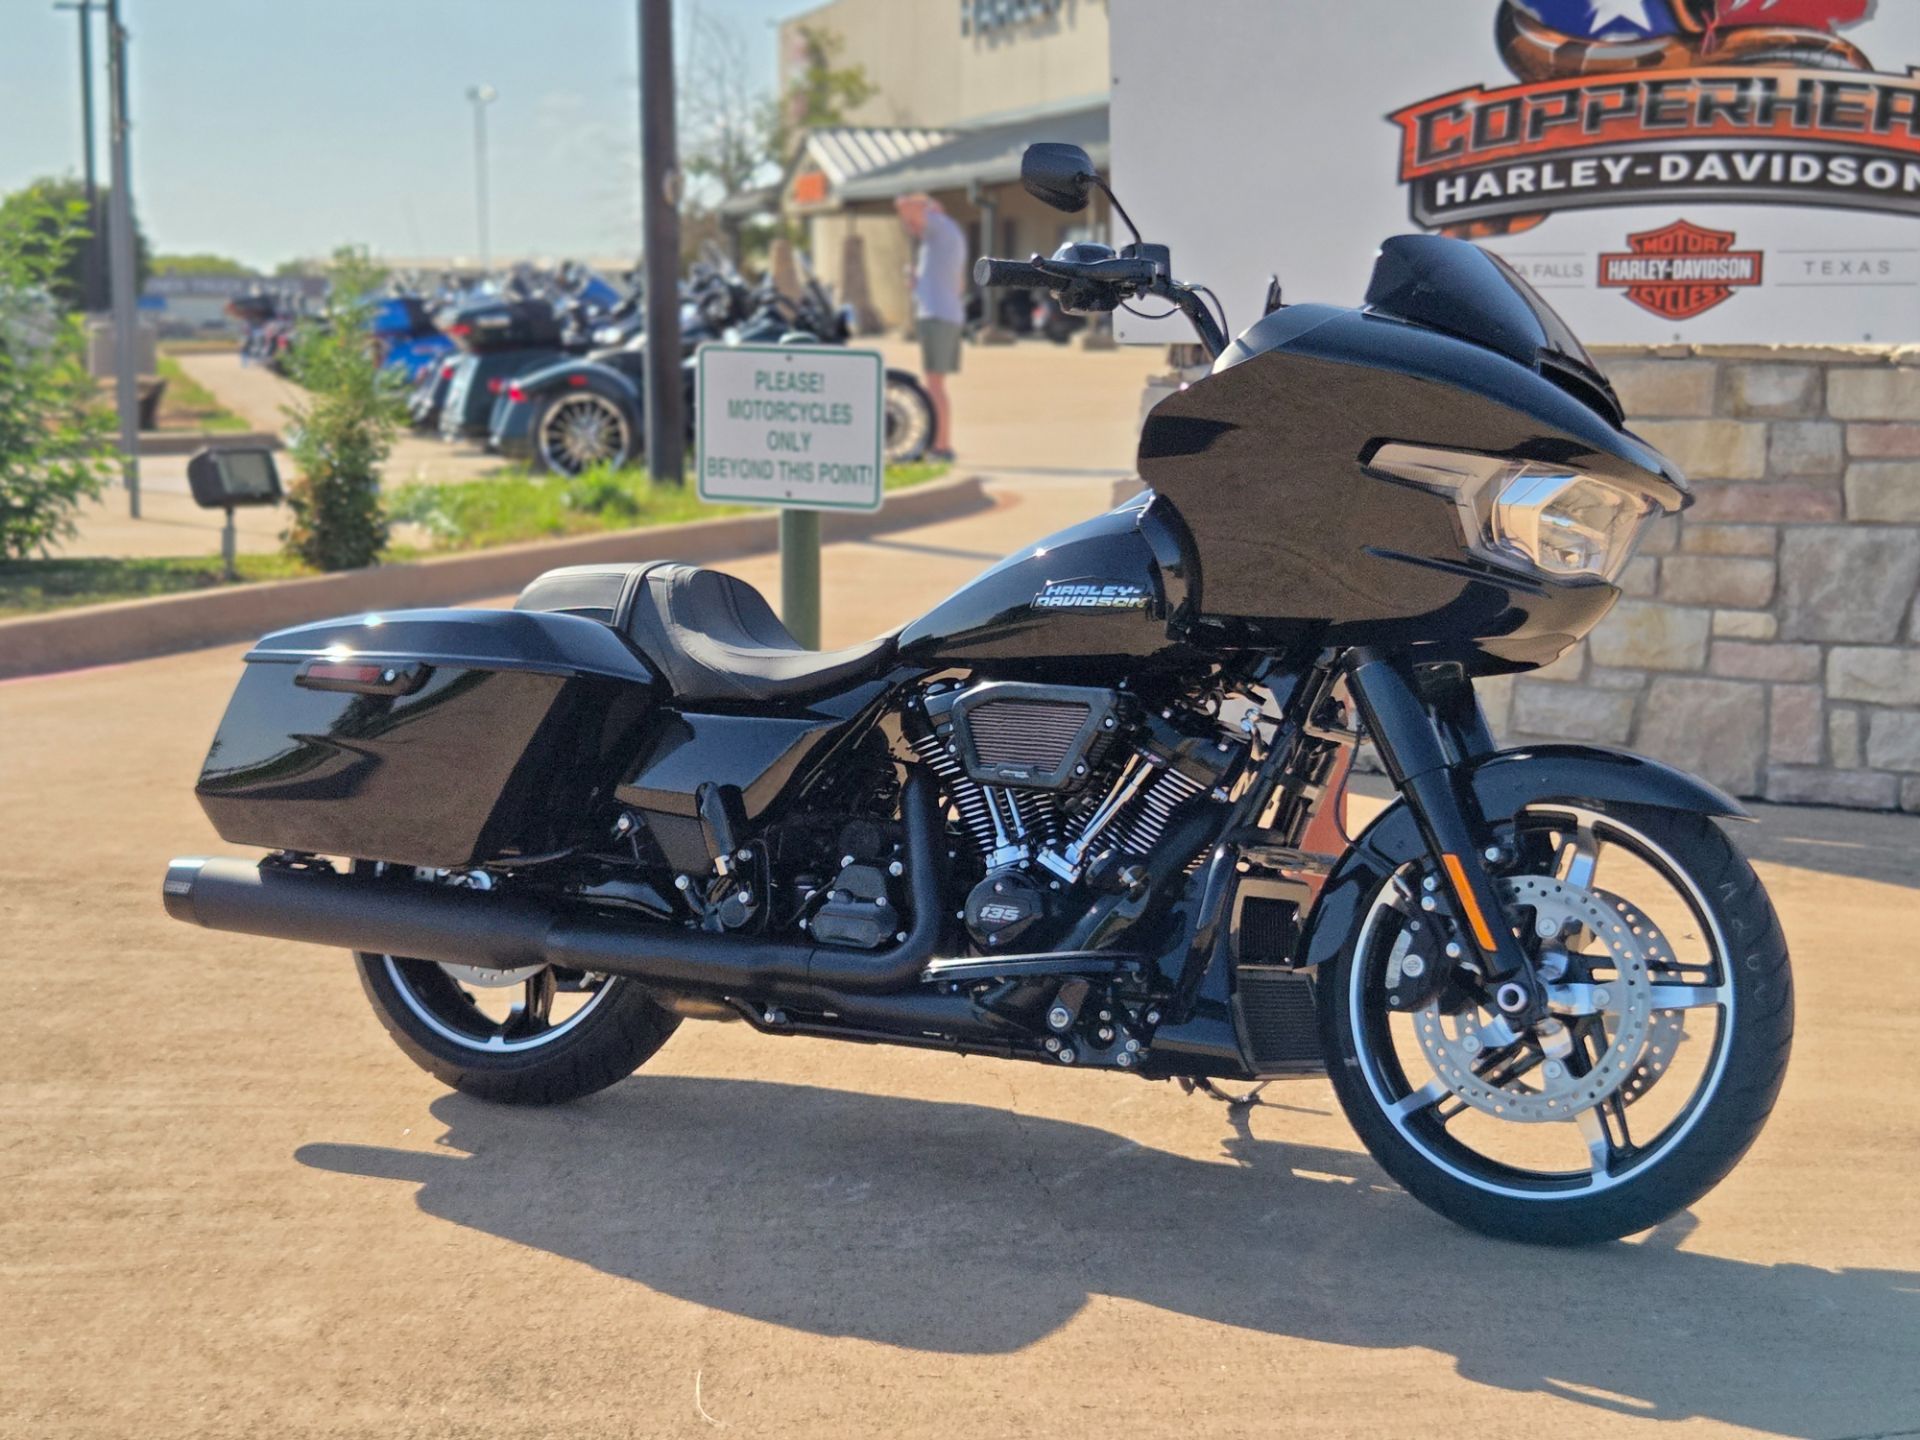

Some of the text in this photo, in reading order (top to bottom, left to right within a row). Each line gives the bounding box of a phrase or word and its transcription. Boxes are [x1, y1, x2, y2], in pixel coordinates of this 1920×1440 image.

[1643, 229, 1718, 252] MOTOR
[1533, 263, 1584, 278] FALLS
[1608, 258, 1753, 280] HARLEY-DAVIDSON
[1804, 259, 1890, 275] TEXAS
[1639, 285, 1717, 314] CYCLES
[755, 371, 824, 392] PLEASE!
[728, 400, 852, 424] MOTORCYCLES
[766, 430, 812, 452] ONLY
[707, 457, 872, 486] BEYOND THIS POINT!
[1046, 584, 1142, 596] HARLEY-
[1035, 596, 1148, 609] DAVIDSON
[980, 906, 1020, 921] 135
